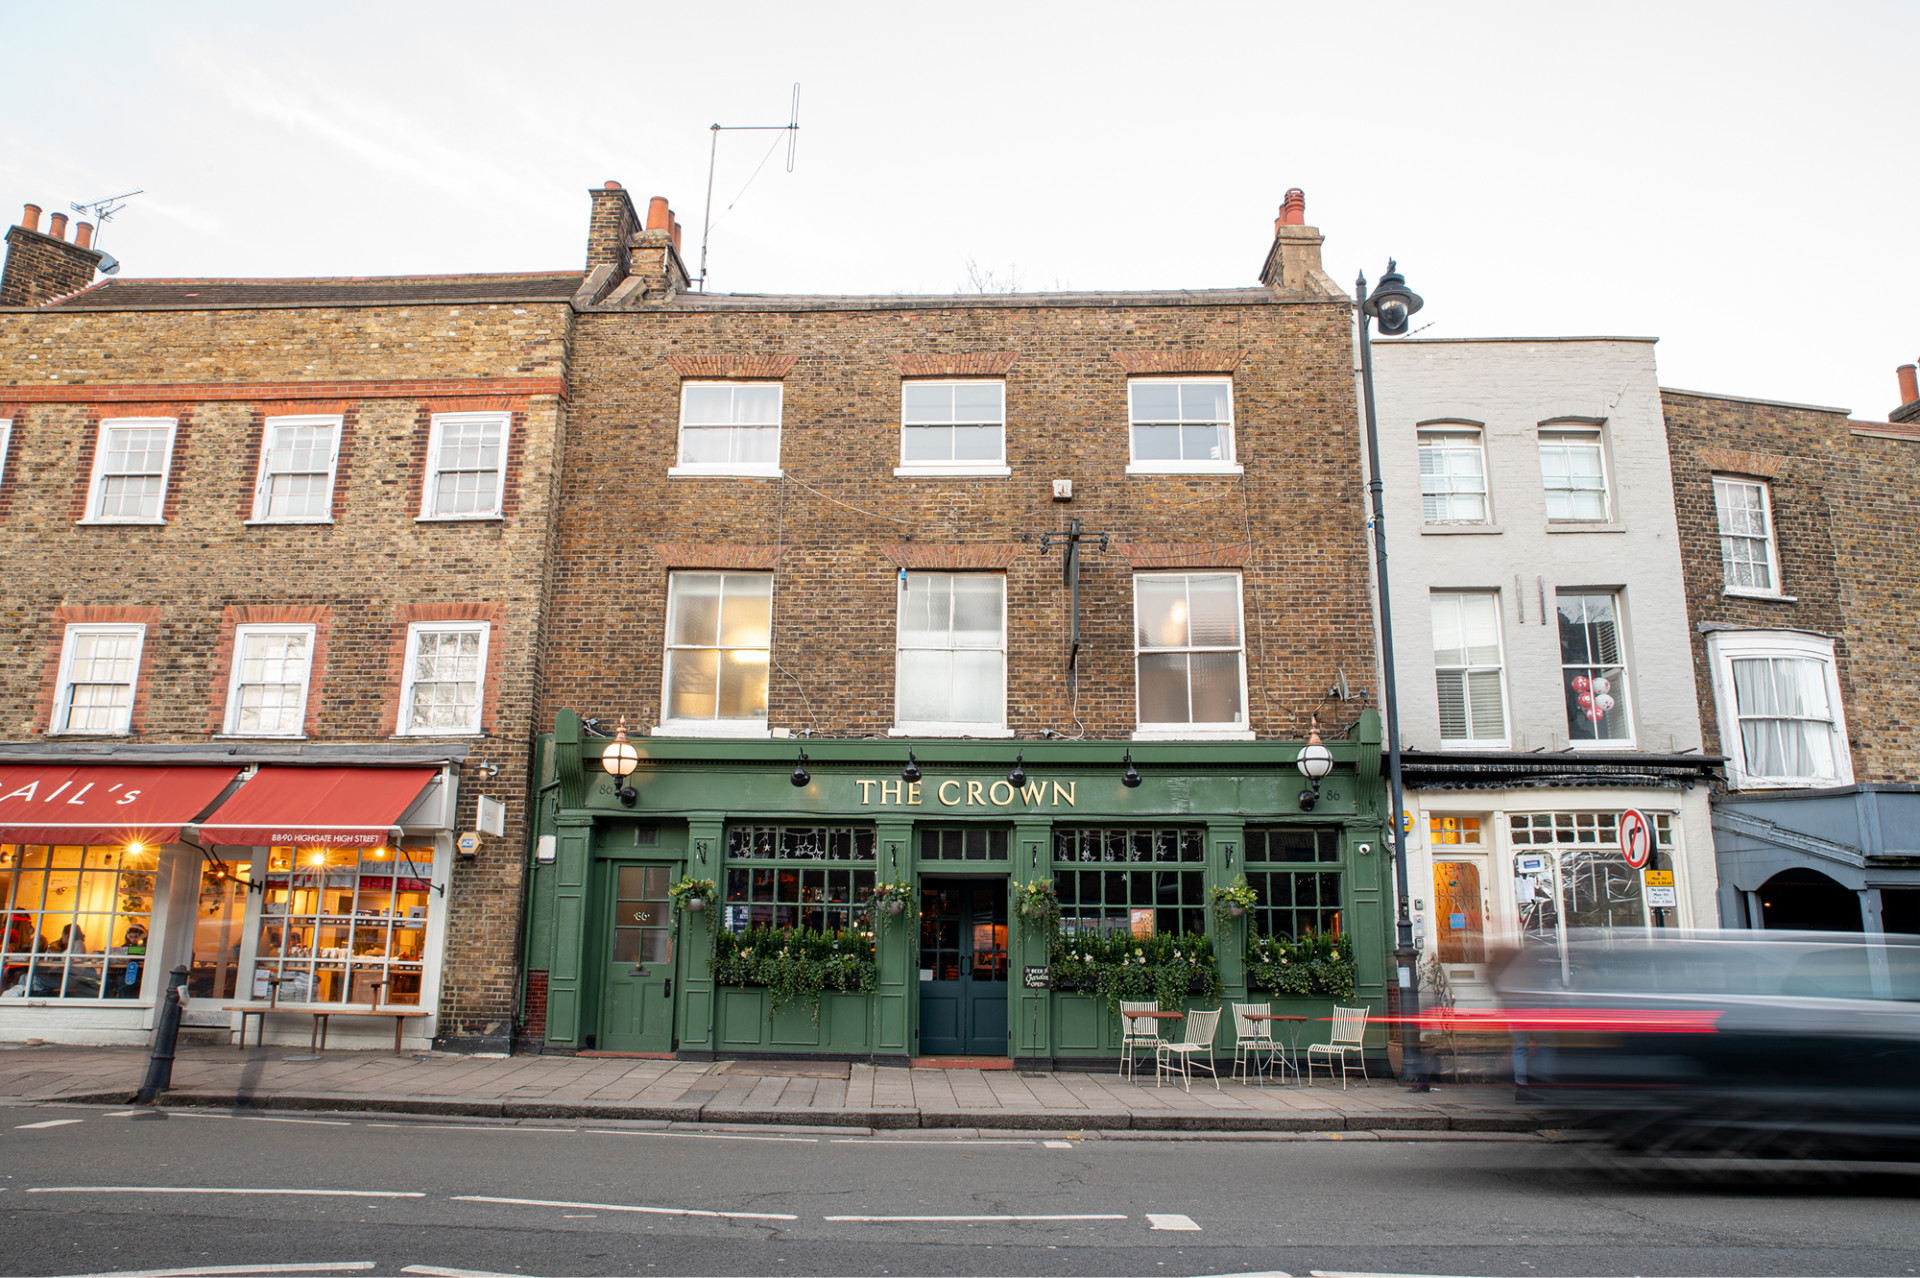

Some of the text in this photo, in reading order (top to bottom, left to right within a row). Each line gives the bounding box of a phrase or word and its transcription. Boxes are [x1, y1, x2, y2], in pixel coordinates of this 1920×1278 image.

[0, 780, 141, 804] AIL's
[855, 780, 1077, 807] THE CROWN
[1326, 790, 1340, 801] 86
[294, 834, 332, 842] HIGHGATE
[333, 835, 353, 843] HIGH
[354, 835, 379, 843] STREET
[1025, 973, 1049, 986] Garden
